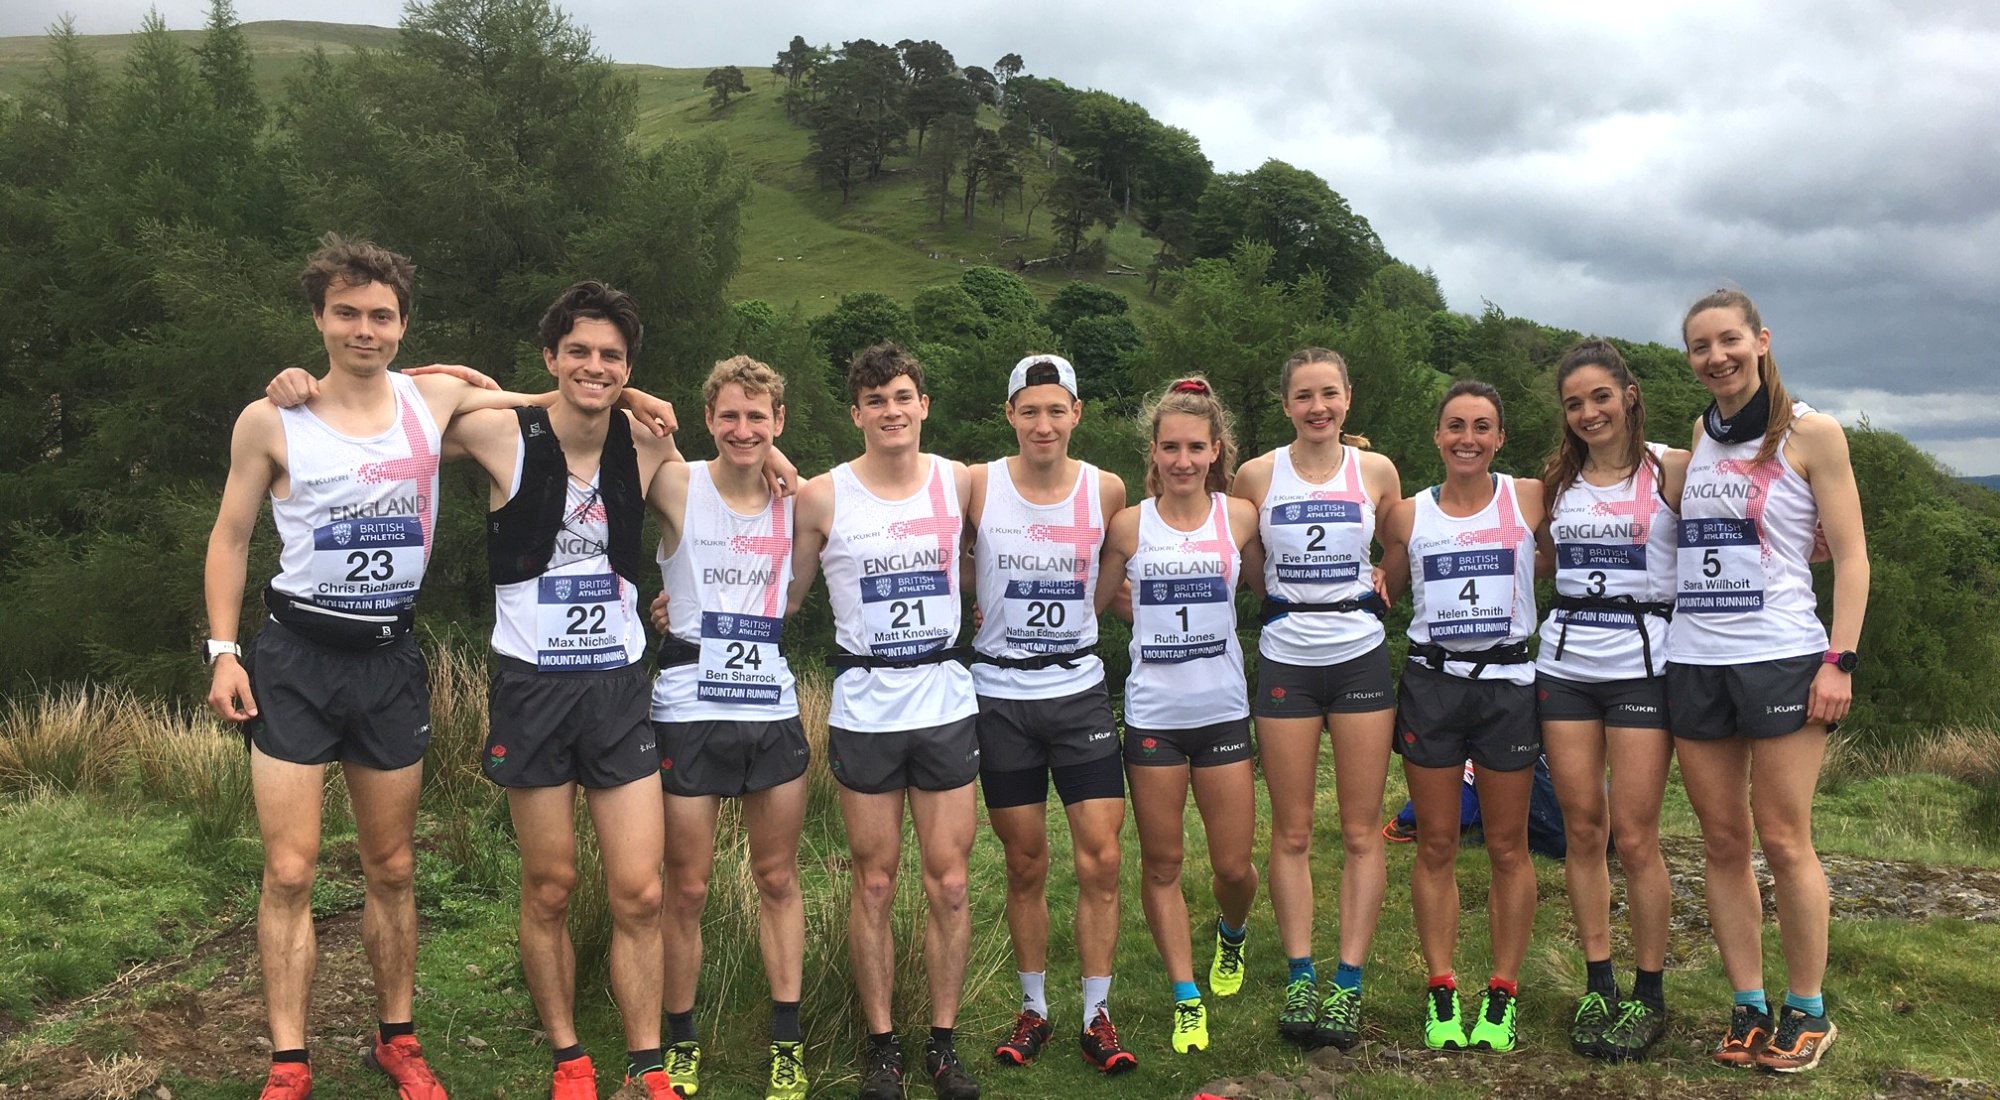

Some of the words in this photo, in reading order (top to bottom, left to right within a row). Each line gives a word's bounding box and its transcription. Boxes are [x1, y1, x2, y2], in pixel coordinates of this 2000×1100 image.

[315, 474, 349, 486] KUKRI
[1684, 482, 1761, 501] ENGLAND
[329, 494, 427, 521] ENGLAND
[1307, 504, 1345, 512] BRITISH
[359, 523, 405, 533] BRITISH
[995, 527, 1021, 535] KUKRI
[1558, 523, 1645, 540] ENGLAND
[1703, 523, 1741, 533] BRITISH
[359, 533, 405, 542] ATHLETICS
[853, 532, 881, 541] KUKRI
[1306, 525, 1326, 552] 2
[1703, 532, 1743, 540] ATHLETICS
[554, 538, 607, 555] NGLA
[700, 539, 726, 547] KUKRI
[1423, 539, 1451, 549] KUKRI
[1282, 554, 1301, 563] Eve
[1303, 553, 1352, 563] Pannone
[1589, 548, 1628, 558] BRITISH
[345, 550, 395, 582] 23
[863, 548, 950, 576] ENGLAND
[998, 554, 1086, 573] ENGLAND
[1458, 555, 1499, 565] BRITISH
[1702, 549, 1721, 578] 5
[1144, 560, 1228, 577] ENGLAND
[1278, 568, 1320, 579] MOUNTAIN
[1321, 566, 1356, 578] RUNNING
[1458, 564, 1499, 572] ATHLETICS
[703, 568, 776, 586] ENGLAND
[898, 576, 934, 586] BRITISH
[1586, 570, 1607, 596] 3
[318, 582, 355, 594] Chris
[360, 580, 415, 594] Richards
[579, 579, 611, 589] BRITISH
[898, 584, 936, 593] ATHLETICS
[1040, 580, 1076, 588] BRITISH
[1174, 583, 1211, 592] BRITISH
[1684, 579, 1703, 590] Sara
[1705, 579, 1750, 590] Willhoit
[578, 588, 612, 597] ATHLETICS
[1458, 578, 1479, 606] 4
[316, 599, 373, 610] MOUNTAIN
[1679, 597, 1714, 608] MOUNTAIN
[1716, 595, 1760, 607] RUNNING
[566, 604, 606, 635] 22
[889, 600, 926, 629] 21
[1026, 601, 1065, 628] 20
[1175, 606, 1189, 632] 1
[1437, 609, 1468, 620] Helen
[1472, 606, 1503, 617] Smith
[1558, 609, 1597, 621] MNTAIN
[1598, 612, 1637, 624] RUNNIN
[739, 619, 771, 630] BRITISH
[1431, 623, 1474, 637] MOUNTAIN
[1476, 621, 1508, 634] RUNNING
[738, 629, 770, 638] ATHLETICS
[875, 632, 900, 642] Matt
[903, 627, 949, 639] Knowles
[1006, 626, 1035, 637] Nathan
[1037, 628, 1081, 638] Edmondson
[1154, 633, 1180, 644] Ruth
[1182, 632, 1215, 643] Jones
[548, 637, 575, 648] Max
[579, 635, 617, 647] Nicholls
[1007, 642, 1047, 653] MOUNTAIN
[1048, 643, 1077, 654] RUNNIN
[725, 642, 762, 671] 24
[874, 644, 917, 657] MOUNTAIN
[1143, 648, 1187, 659] MOUNTAIN
[1188, 644, 1224, 656] RUNNING
[540, 654, 591, 666] MOUNTAIN
[593, 650, 626, 664] RUNNING
[705, 670, 728, 681] Ben
[731, 671, 777, 683] Sharrock
[700, 686, 745, 698] MOUNTAIN
[746, 688, 779, 700] RUNNING
[1353, 690, 1384, 699] KUKRI
[1625, 704, 1657, 713] KUKRI
[1220, 742, 1245, 752] KUKR
